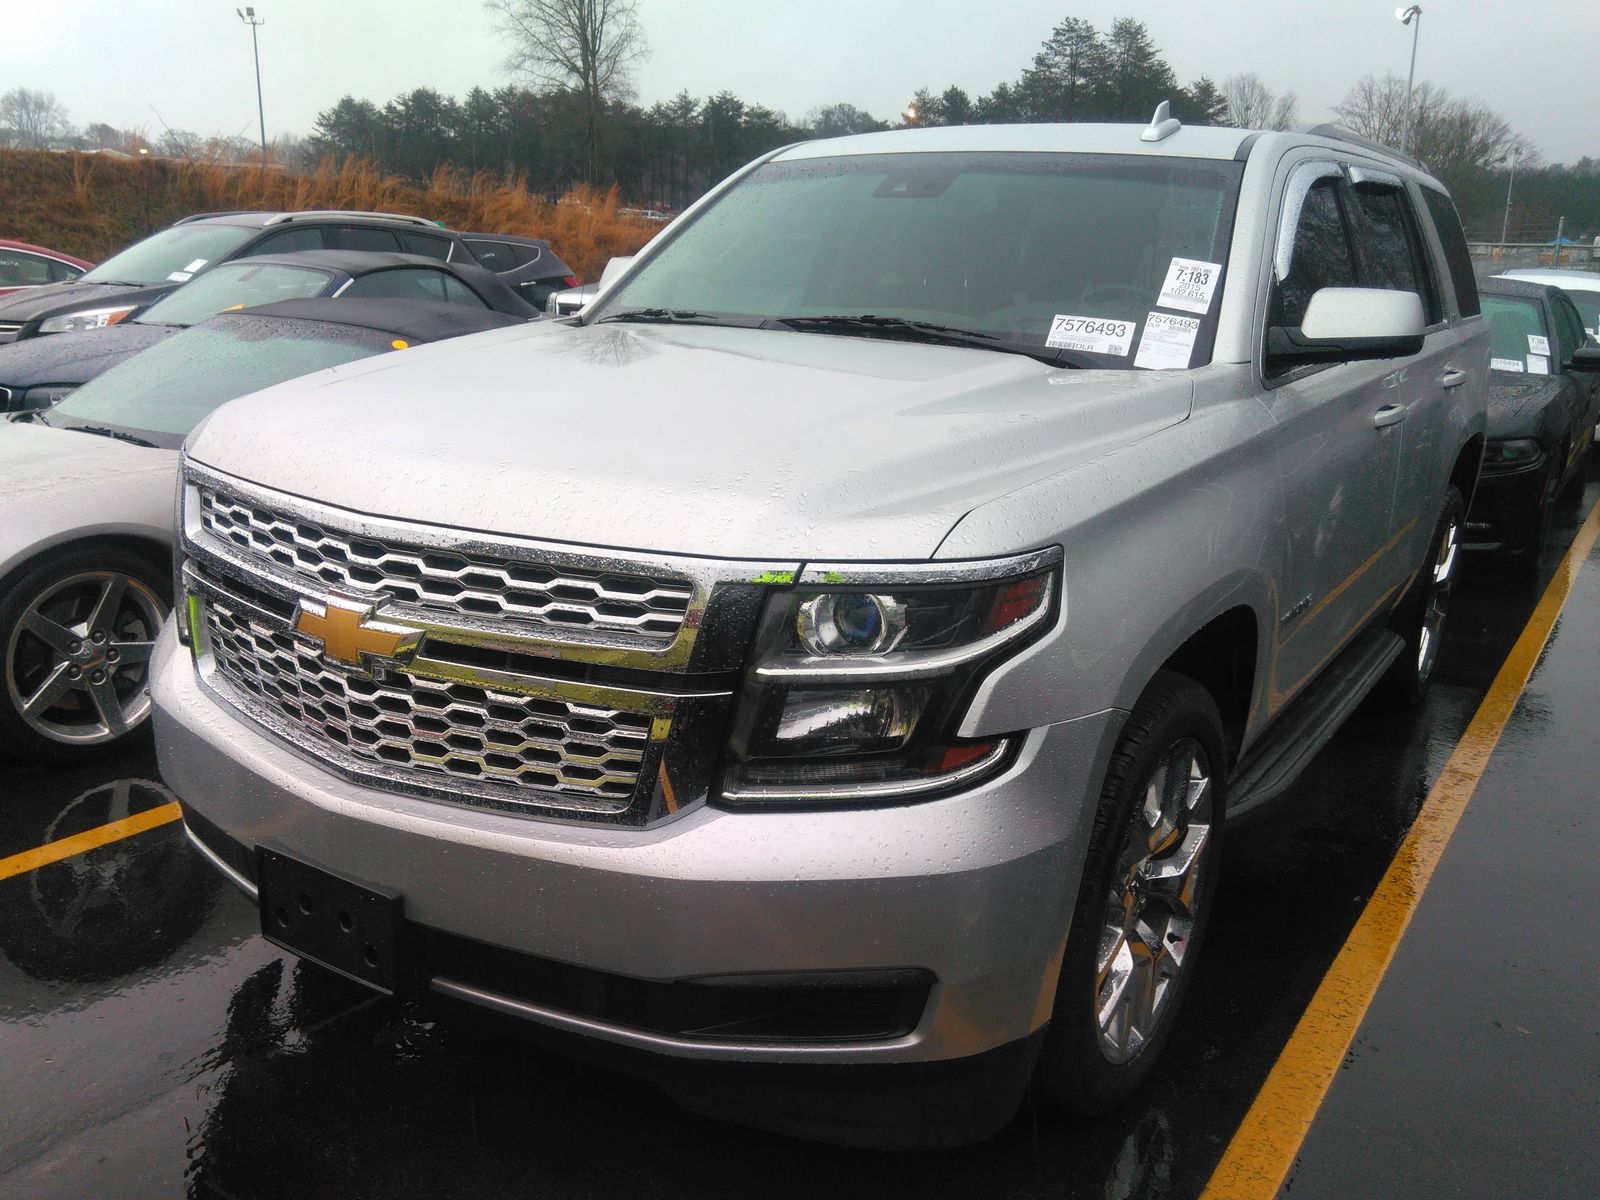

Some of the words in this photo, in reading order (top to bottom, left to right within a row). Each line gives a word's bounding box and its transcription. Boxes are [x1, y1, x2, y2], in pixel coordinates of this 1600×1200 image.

[1176, 269, 1209, 285] 7:183
[1055, 318, 1126, 337] 7576493
[1148, 314, 1199, 329] 7576493
